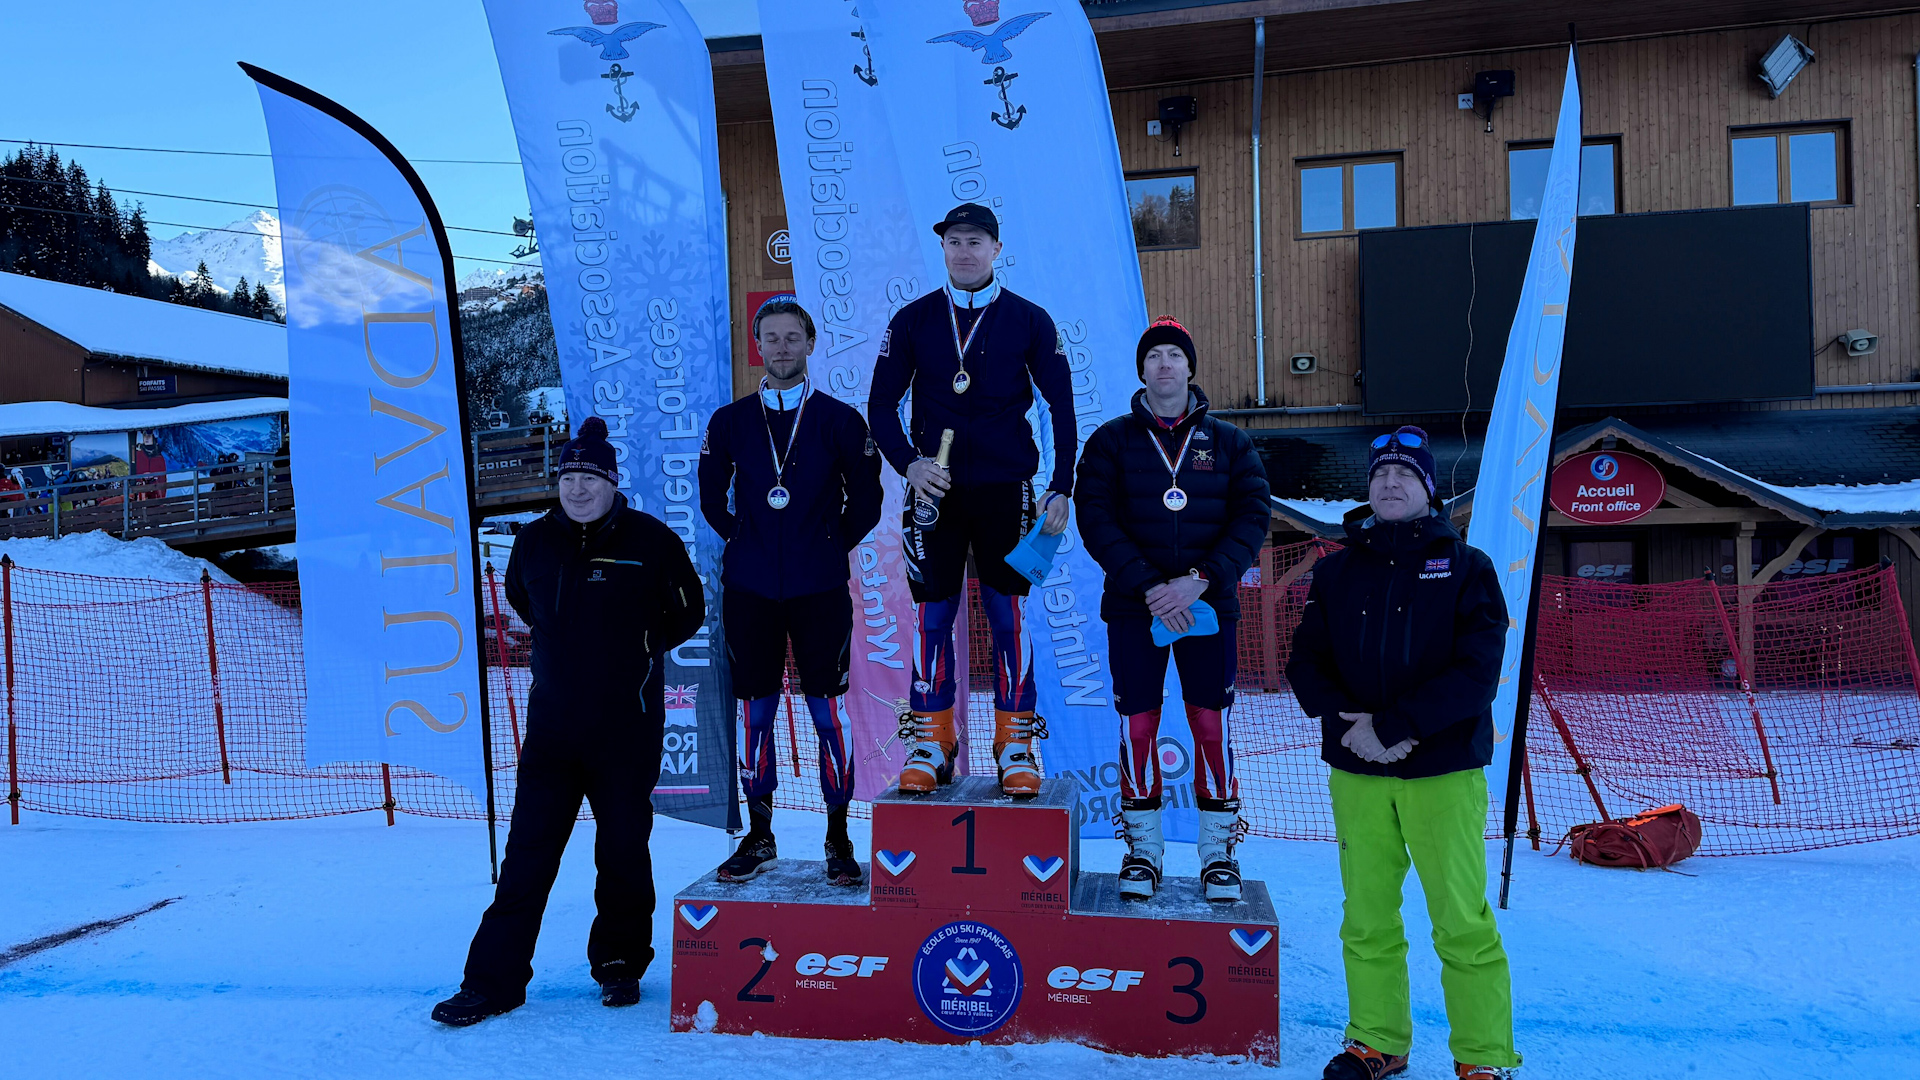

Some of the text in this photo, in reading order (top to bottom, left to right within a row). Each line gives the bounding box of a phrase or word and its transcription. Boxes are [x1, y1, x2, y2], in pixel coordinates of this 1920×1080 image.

[1576, 484, 1635, 498] Accueil
[1571, 501, 1641, 512] Front office
[1018, 512, 1029, 540] REAT
[950, 810, 987, 875] 1
[874, 884, 917, 896] MÉRIBEL
[1021, 890, 1066, 902] MÉRIBEL
[677, 938, 718, 950] MÉRIBEL
[945, 925, 958, 936] DU
[960, 924, 974, 934] SKI
[976, 926, 1014, 960] FRANÇAIS
[736, 937, 776, 1003] 2
[1228, 964, 1274, 977] MÉRIBEL
[796, 978, 838, 990] MÉRIBEL
[1166, 956, 1206, 1024] 3
[940, 997, 994, 1012] MÉRIBEL
[1047, 992, 1092, 1004] MÉRIBEL
